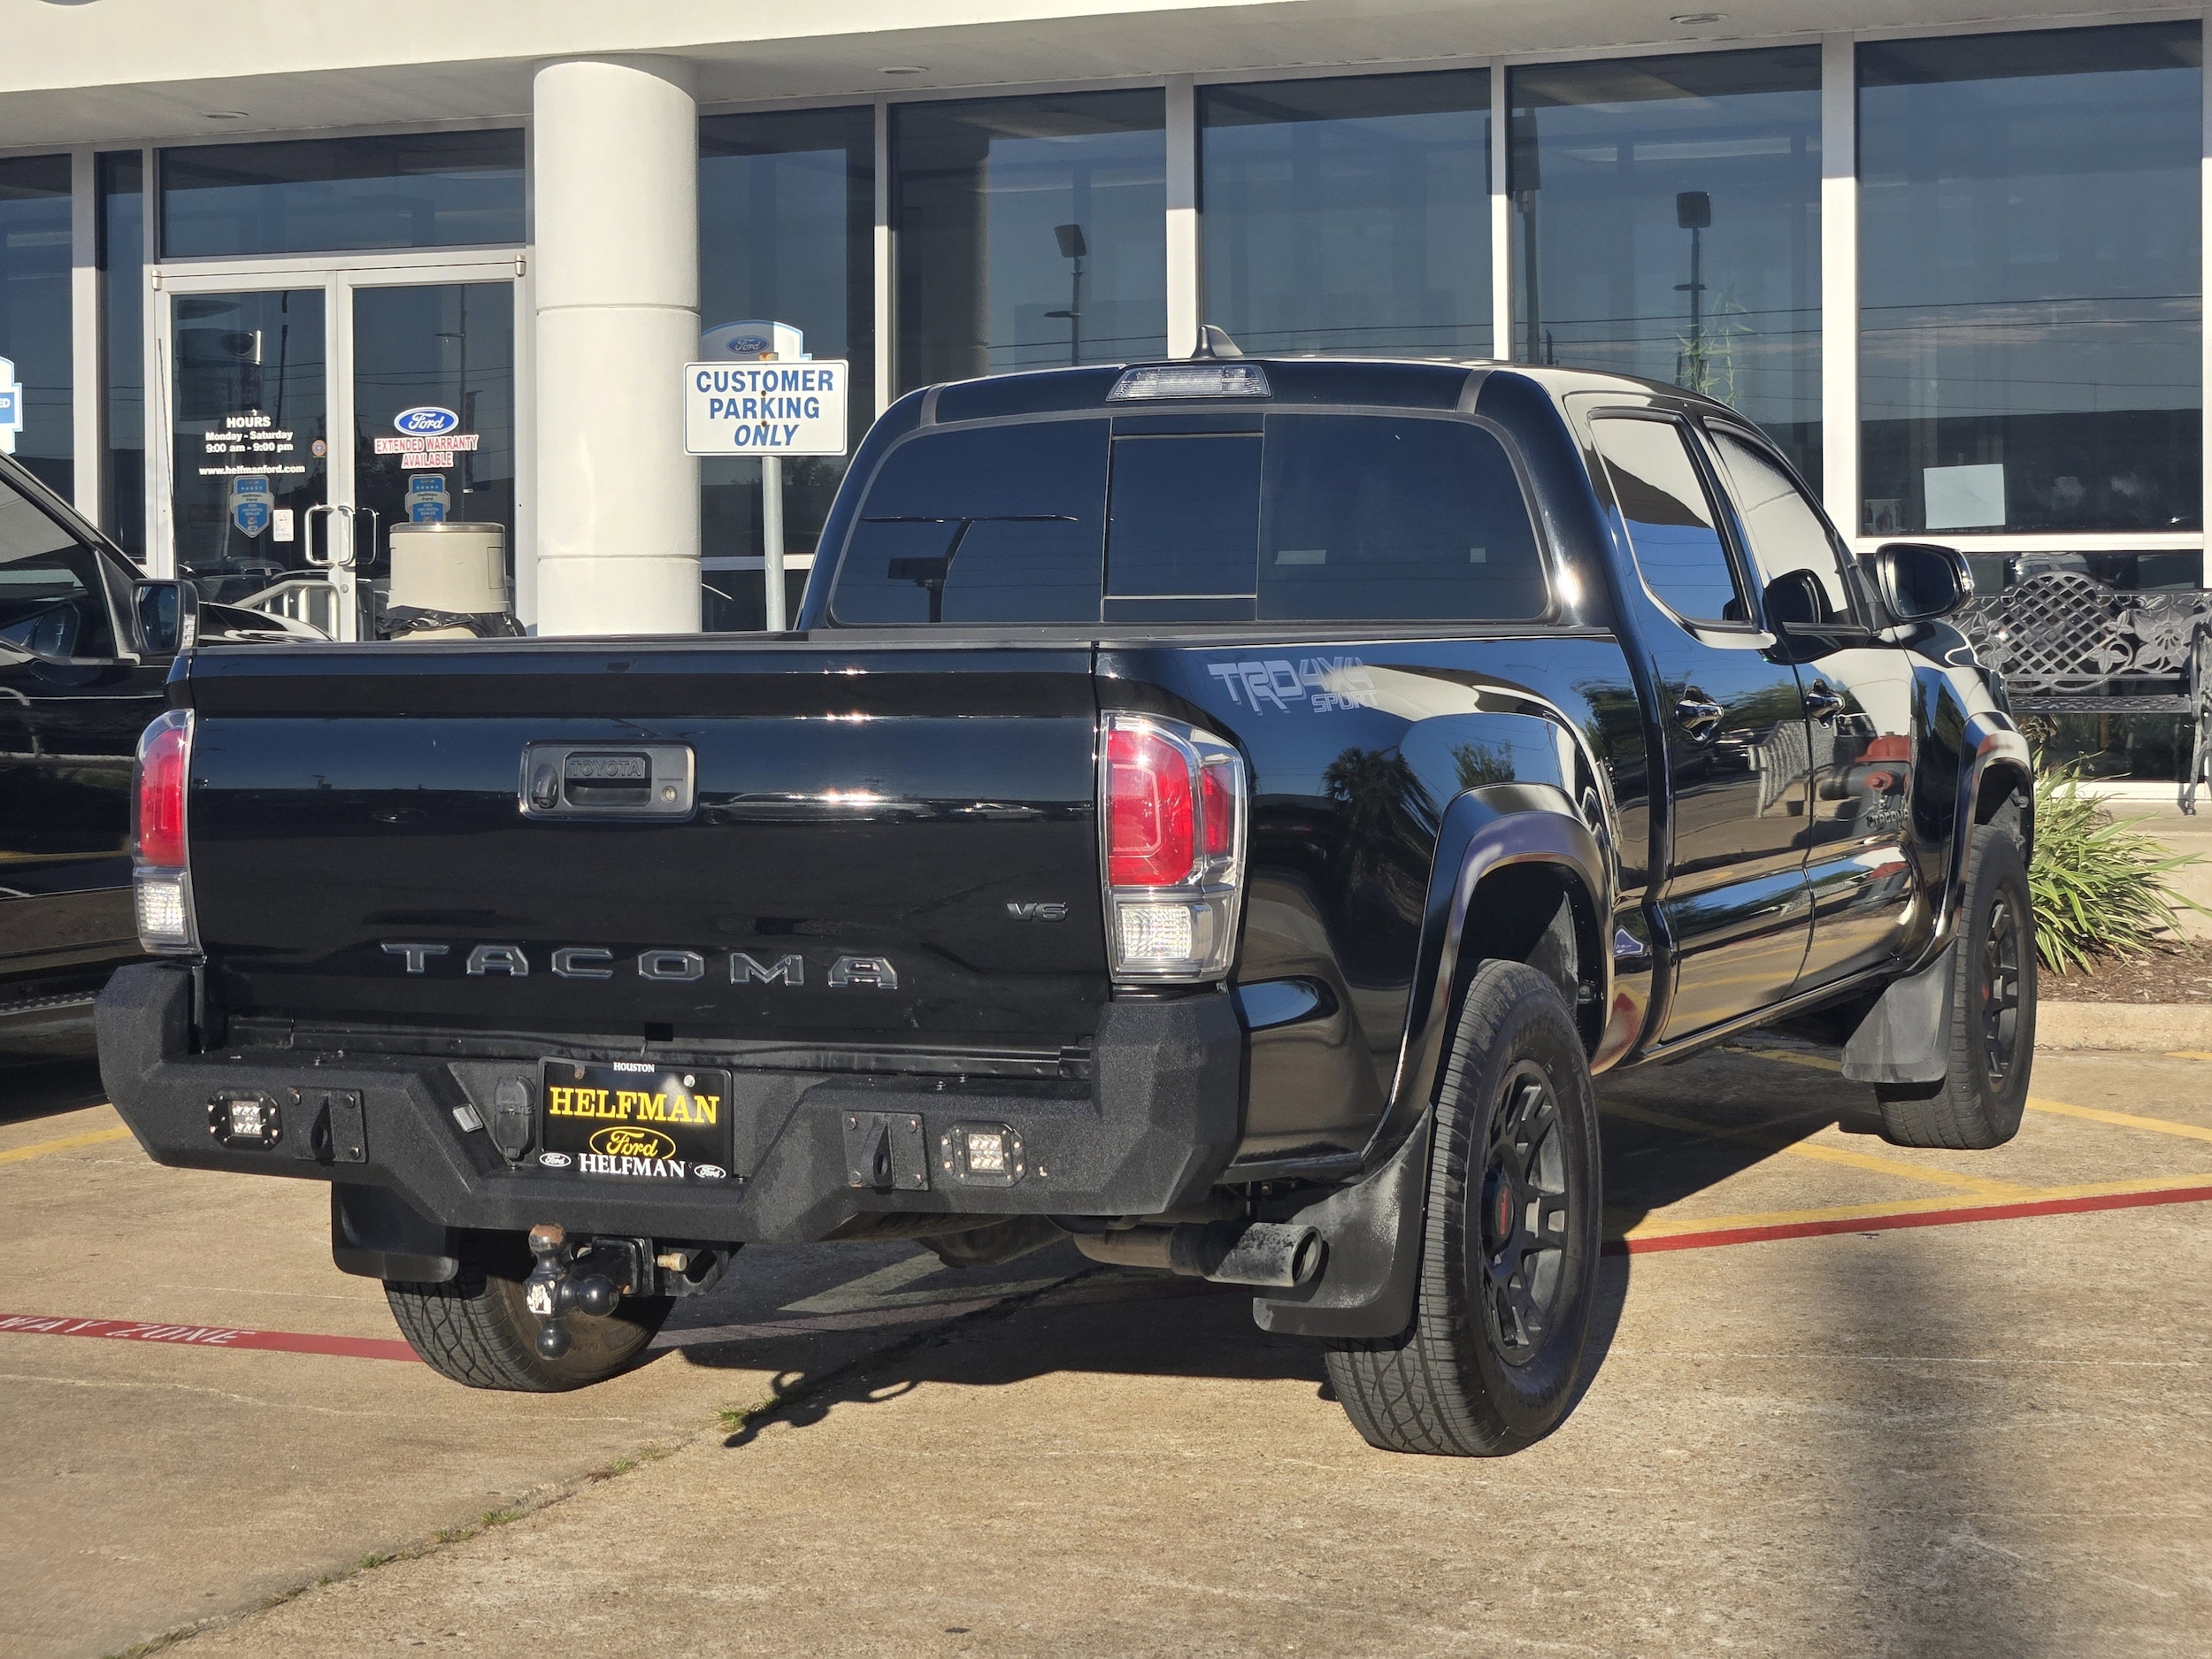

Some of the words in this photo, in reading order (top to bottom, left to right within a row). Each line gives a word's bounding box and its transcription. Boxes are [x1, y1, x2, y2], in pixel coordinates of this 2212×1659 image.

[734, 338, 762, 351] Ford
[696, 370, 833, 393] CUSTOMER
[710, 397, 819, 419] PARKING
[226, 416, 272, 428] HOURS
[408, 412, 444, 430] Ford
[205, 432, 242, 442] Monday
[250, 430, 294, 441] Saturday
[376, 438, 424, 452] EXTENDED
[426, 435, 478, 450] WARRANTY
[733, 424, 800, 447] ONLY
[205, 443, 227, 453] 9:00
[253, 442, 275, 451] 9:00
[277, 443, 294, 453] pm
[403, 452, 452, 467] AVAILABLE
[199, 465, 305, 475] www.helfmanford.com
[1207, 660, 1307, 716] TRD
[1311, 690, 1379, 713] SPORT
[570, 760, 641, 777] TOYOTA
[1006, 902, 1068, 921] V6
[380, 941, 899, 989] TACOMA
[612, 1061, 656, 1073] HOUSTON
[549, 1087, 720, 1124] HELFMAN
[605, 1129, 659, 1158] Ford
[578, 1152, 686, 1179] HELFMAN
[105, 1324, 256, 1343] ZONE
